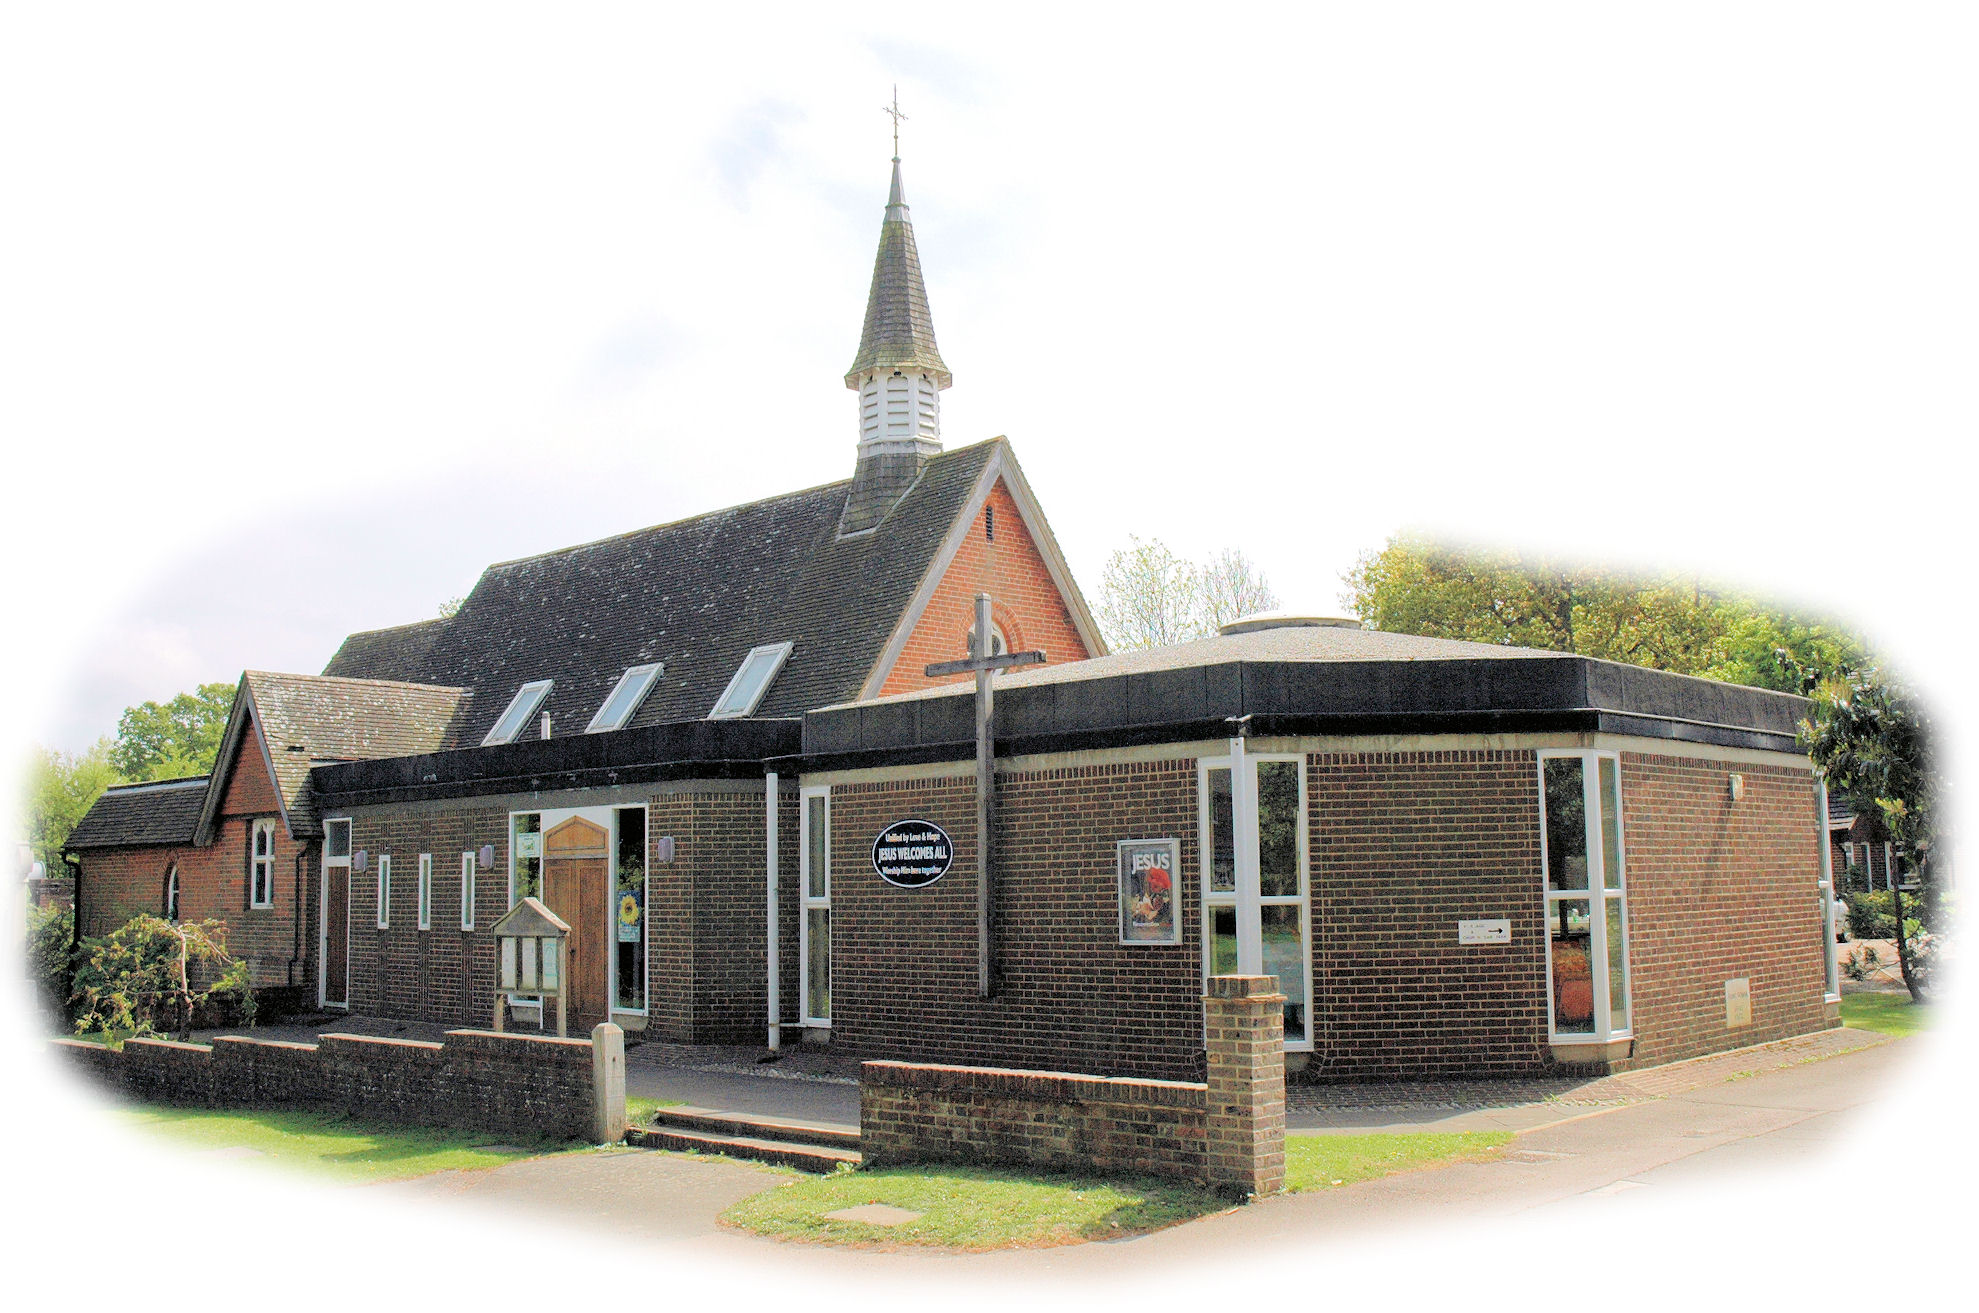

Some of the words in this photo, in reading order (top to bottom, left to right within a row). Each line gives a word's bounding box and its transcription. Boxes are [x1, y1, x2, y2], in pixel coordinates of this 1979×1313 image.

[903, 833, 910, 843] by
[878, 847, 897, 864] JESUS
[897, 847, 934, 860] WELCOMES
[934, 845, 948, 859] ALL
[1132, 853, 1170, 875] JESUS
